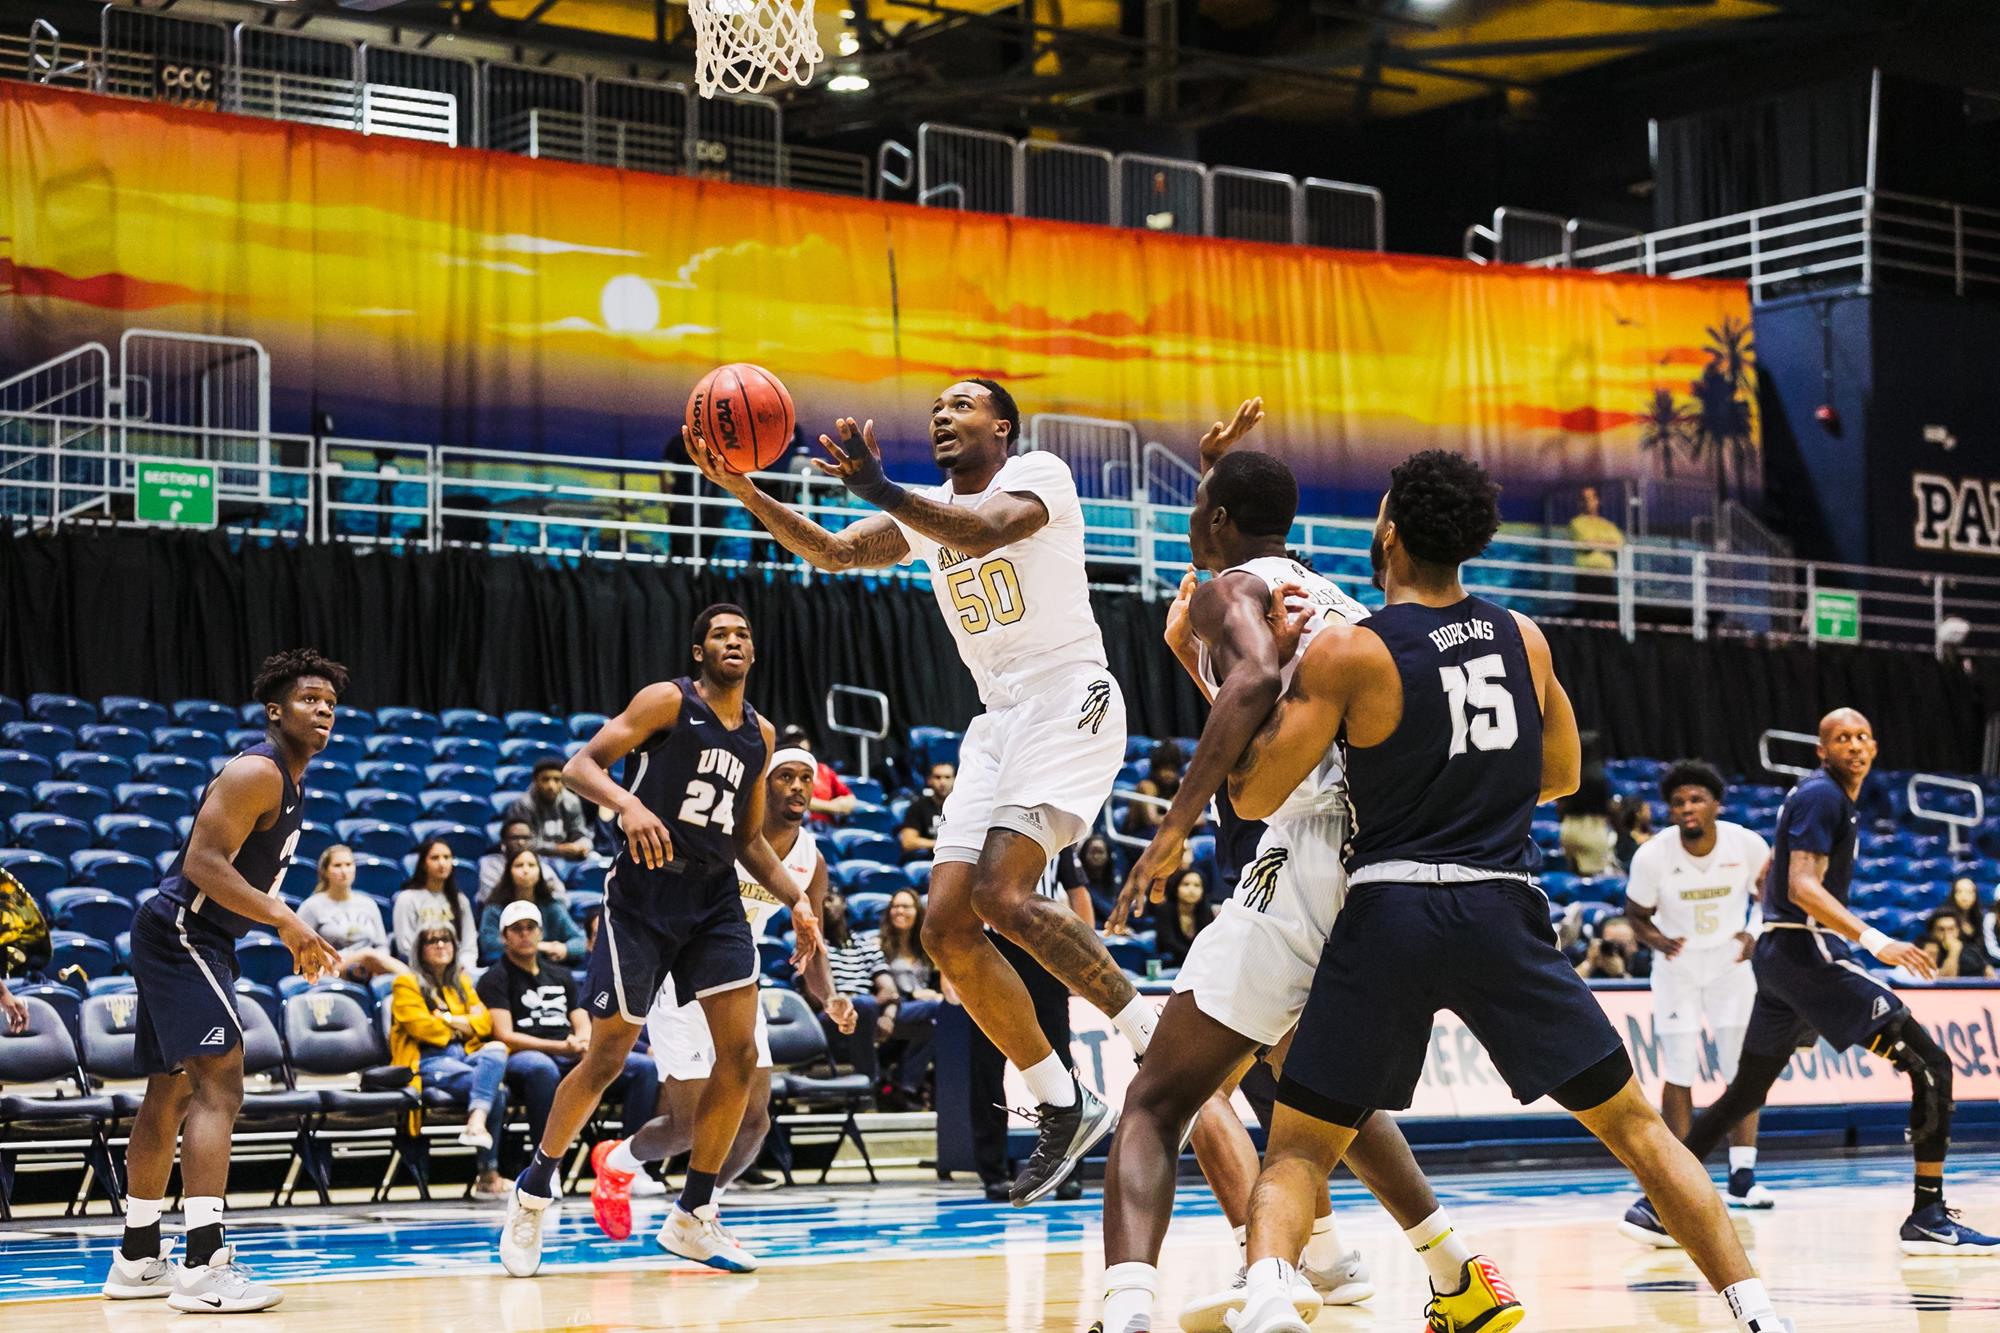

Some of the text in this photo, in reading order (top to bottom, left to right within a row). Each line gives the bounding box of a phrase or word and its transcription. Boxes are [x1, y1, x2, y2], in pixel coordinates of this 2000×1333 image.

[716, 398, 741, 450] NCAA
[946, 557, 1026, 635] 50
[1428, 618, 1495, 653] HOPKINS
[1438, 653, 1519, 760] 15
[678, 779, 735, 836] 24
[1694, 903, 1720, 935] 5
